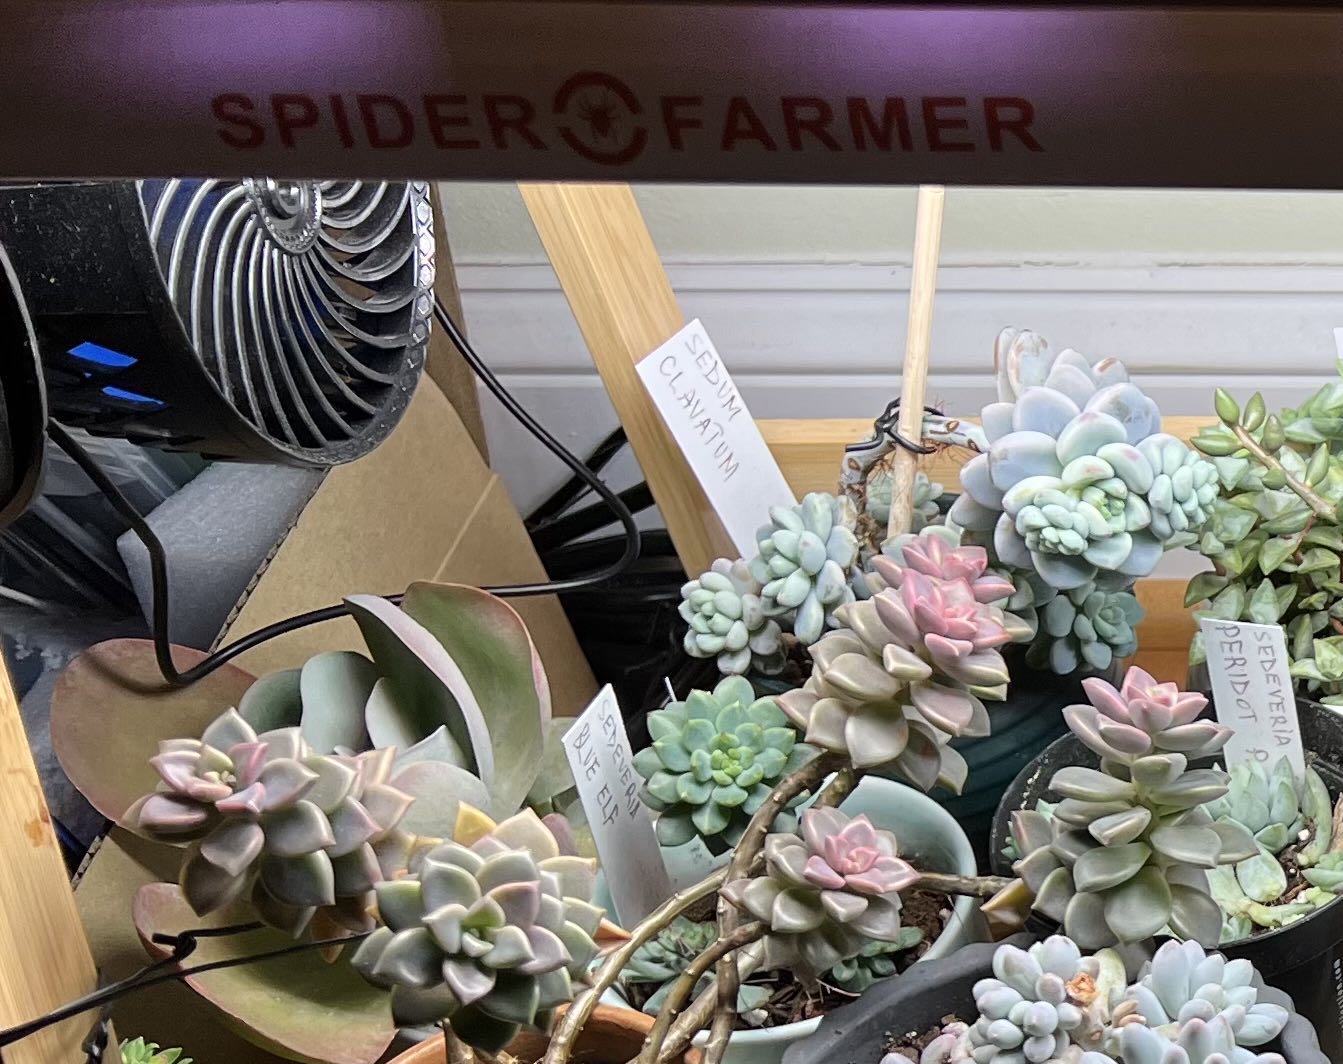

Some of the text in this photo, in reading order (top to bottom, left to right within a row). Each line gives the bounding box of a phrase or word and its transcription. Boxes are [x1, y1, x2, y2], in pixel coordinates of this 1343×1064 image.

[211, 93, 1046, 153] SPIDER FARMER
[659, 355, 740, 482] CLAVATUM
[684, 333, 743, 421] SEDUM
[1214, 625, 1258, 723] PERIDOT
[596, 783, 619, 826] ELF
